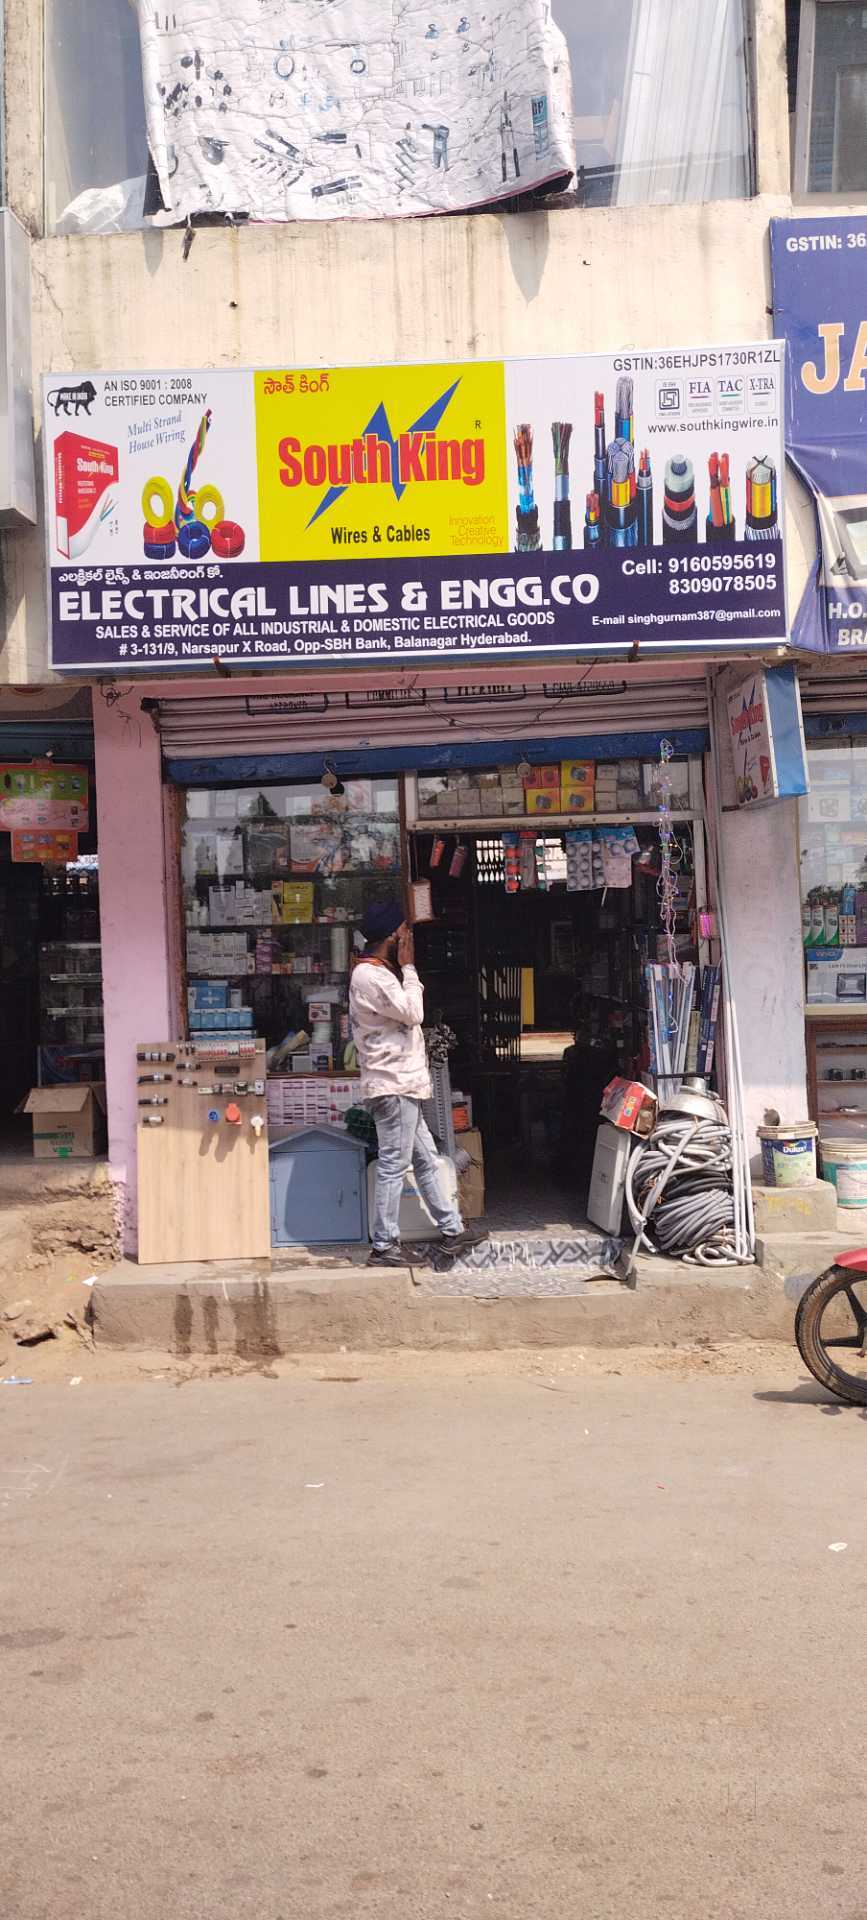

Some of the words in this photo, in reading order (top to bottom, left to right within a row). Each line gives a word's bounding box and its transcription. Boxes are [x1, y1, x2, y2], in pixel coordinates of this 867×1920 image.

[786, 234, 842, 252] GSTIN:
[613, 350, 781, 371] GSTIN:36EHJPS1730R1ZL
[104, 381, 118, 392] AN
[120, 380, 138, 391] ISO
[140, 379, 162, 390] 9001
[170, 378, 192, 389] 2008
[718, 379, 743, 392] TAC
[104, 395, 156, 407] CERTIFIED
[158, 393, 208, 405] COMPANY
[128, 419, 152, 438] Multi
[154, 409, 182, 430] Strand
[648, 417, 779, 434] www.southkingwire.in
[129, 439, 155, 454] House
[156, 430, 186, 446] Wiring
[278, 433, 391, 487] South
[400, 431, 486, 486] King
[331, 526, 368, 544] Wires
[373, 526, 382, 543] &
[386, 524, 431, 543] Cables
[621, 559, 663, 575] Cell:
[668, 553, 776, 573] 9160595619
[132, 570, 141, 580] &
[669, 575, 777, 594] 8309078505
[59, 587, 277, 622] ELECTRICAL
[289, 583, 389, 615] LINES
[401, 581, 427, 611] &
[441, 573, 600, 610] ENGG.CO
[95, 626, 138, 639] SALES
[142, 625, 151, 638] &
[154, 624, 209, 638] SERVICE
[213, 624, 231, 636] OF
[233, 622, 258, 636] ALL
[261, 620, 338, 635] INDUSTRIAL
[341, 620, 350, 632] &
[354, 617, 420, 632] DOMESTIC
[424, 614, 505, 630] ELECTRICAL
[507, 611, 555, 626] GOODS
[592, 615, 625, 626] E-mail
[627, 608, 781, 625] singhgurnam387@gmail.com
[119, 644, 127, 656] #
[130, 642, 178, 657] 3-131/9,
[182, 642, 239, 657] Narsapur
[242, 641, 252, 652] X
[255, 640, 291, 653] Road,
[294, 637, 351, 653] Opp-SBH
[355, 636, 391, 650] Bank,
[394, 634, 458, 649] Balanagar
[460, 632, 532, 648] Hyderabad.
[838, 628, 867, 646] BR
